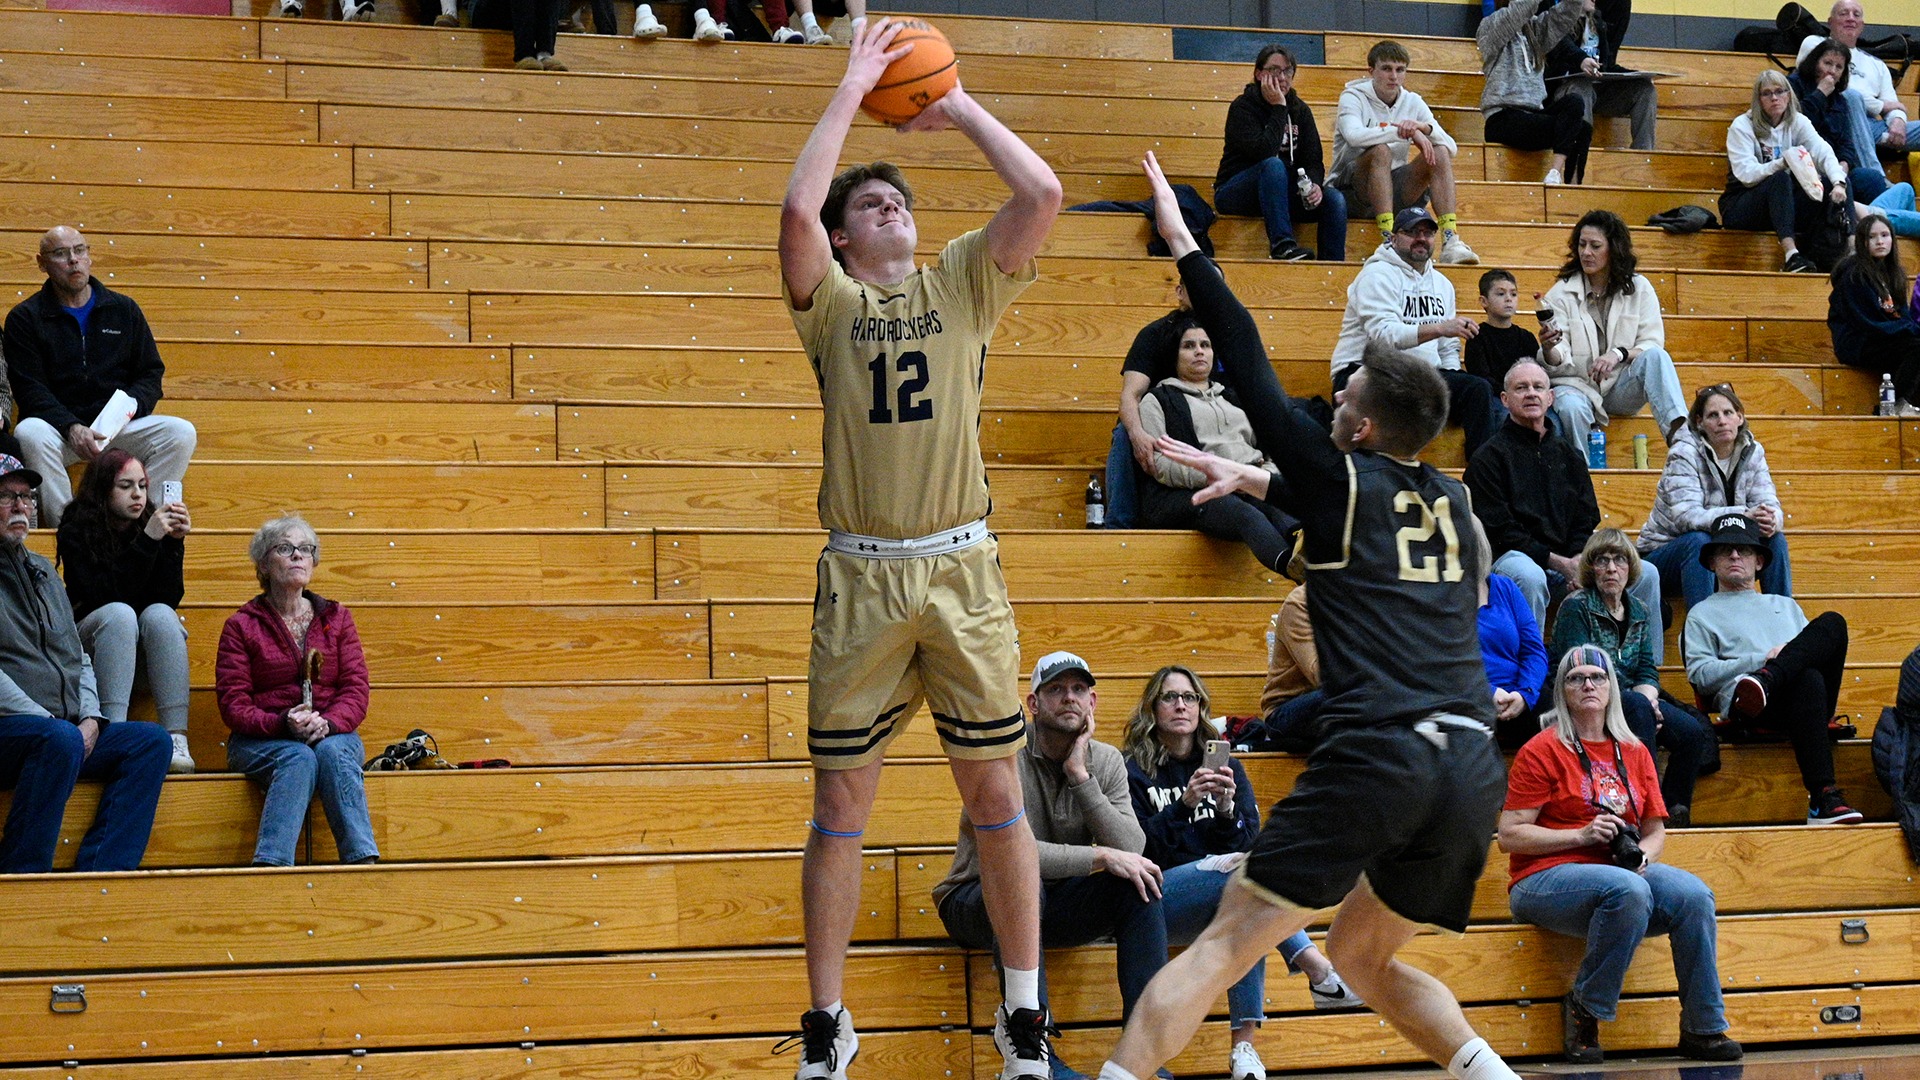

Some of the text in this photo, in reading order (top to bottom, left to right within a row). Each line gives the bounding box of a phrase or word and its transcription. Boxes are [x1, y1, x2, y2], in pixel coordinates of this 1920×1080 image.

[850, 309, 943, 342] HARDROCKERS
[1403, 295, 1445, 318] MINES
[868, 350, 934, 424] 12
[1393, 490, 1465, 583] 21
